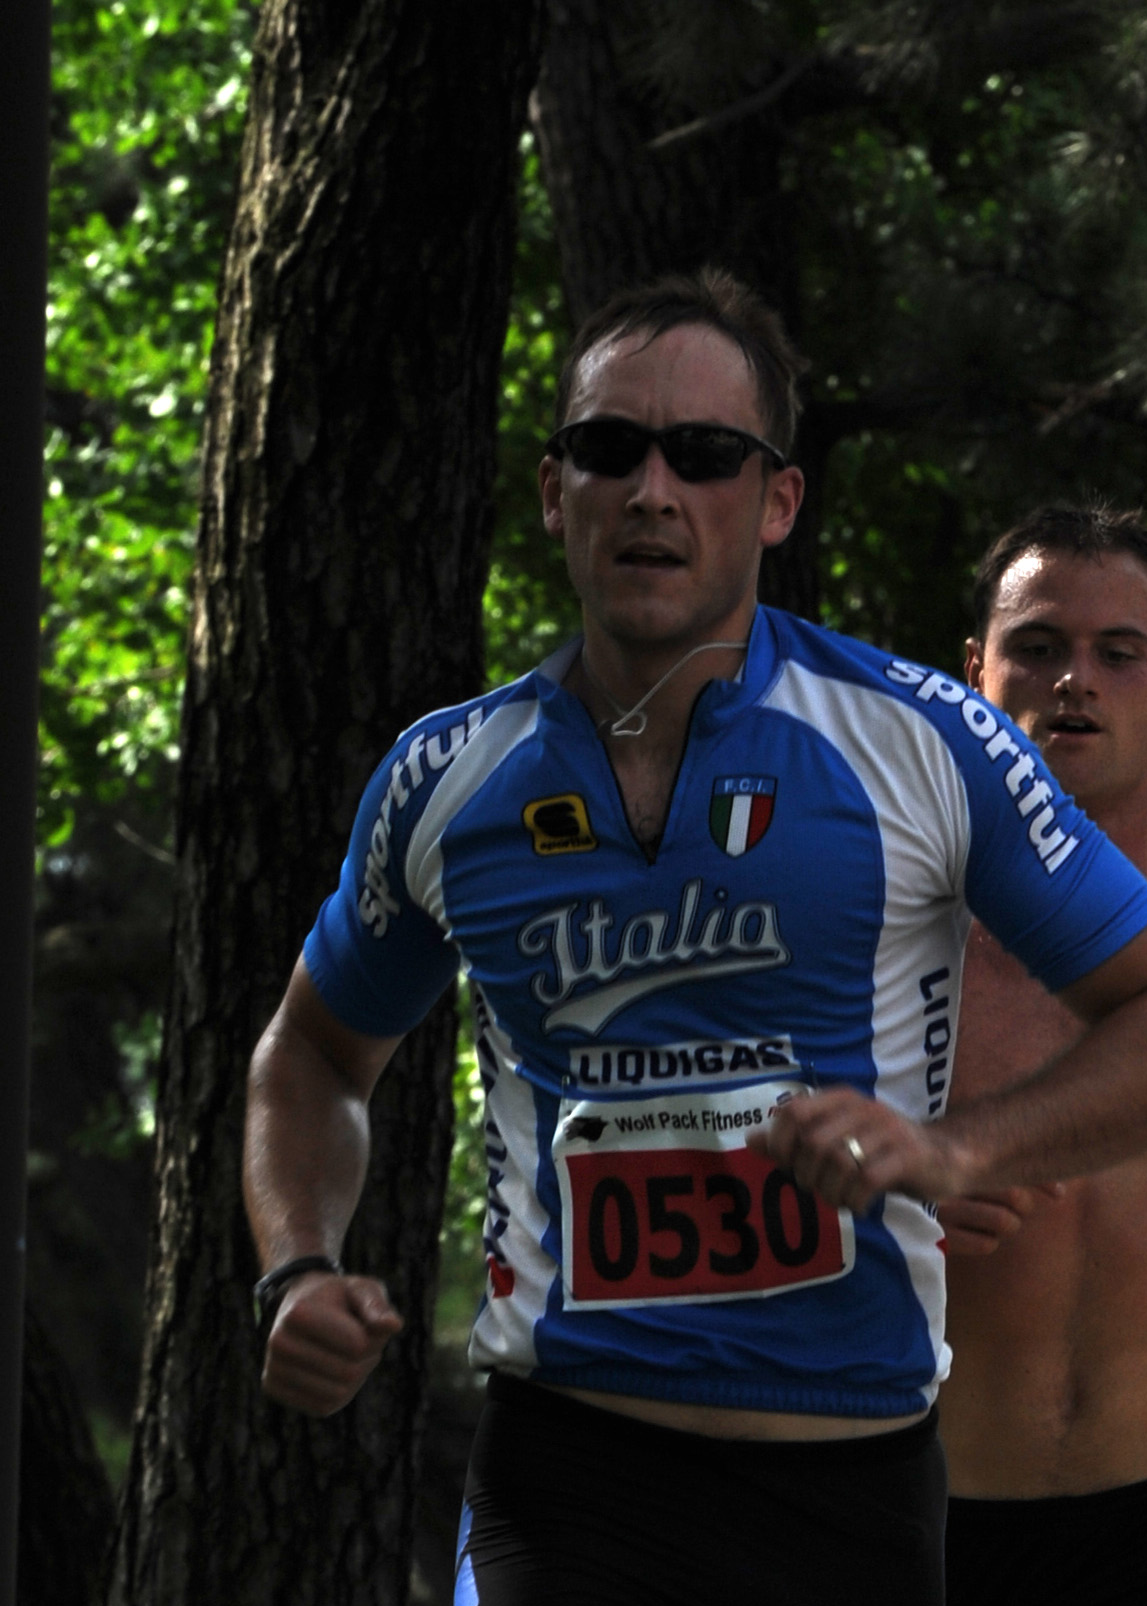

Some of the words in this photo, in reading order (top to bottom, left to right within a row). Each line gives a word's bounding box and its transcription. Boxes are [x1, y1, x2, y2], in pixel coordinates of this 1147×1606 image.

[359, 707, 483, 939] sportful
[886, 660, 1081, 875] sportful
[518, 878, 789, 1006] Italia
[579, 1040, 790, 1085] LIQUIGAS
[615, 1112, 656, 1133] Wolf
[658, 1109, 700, 1131] Pack
[702, 1107, 763, 1132] Fitness
[588, 1167, 820, 1282] 0530
